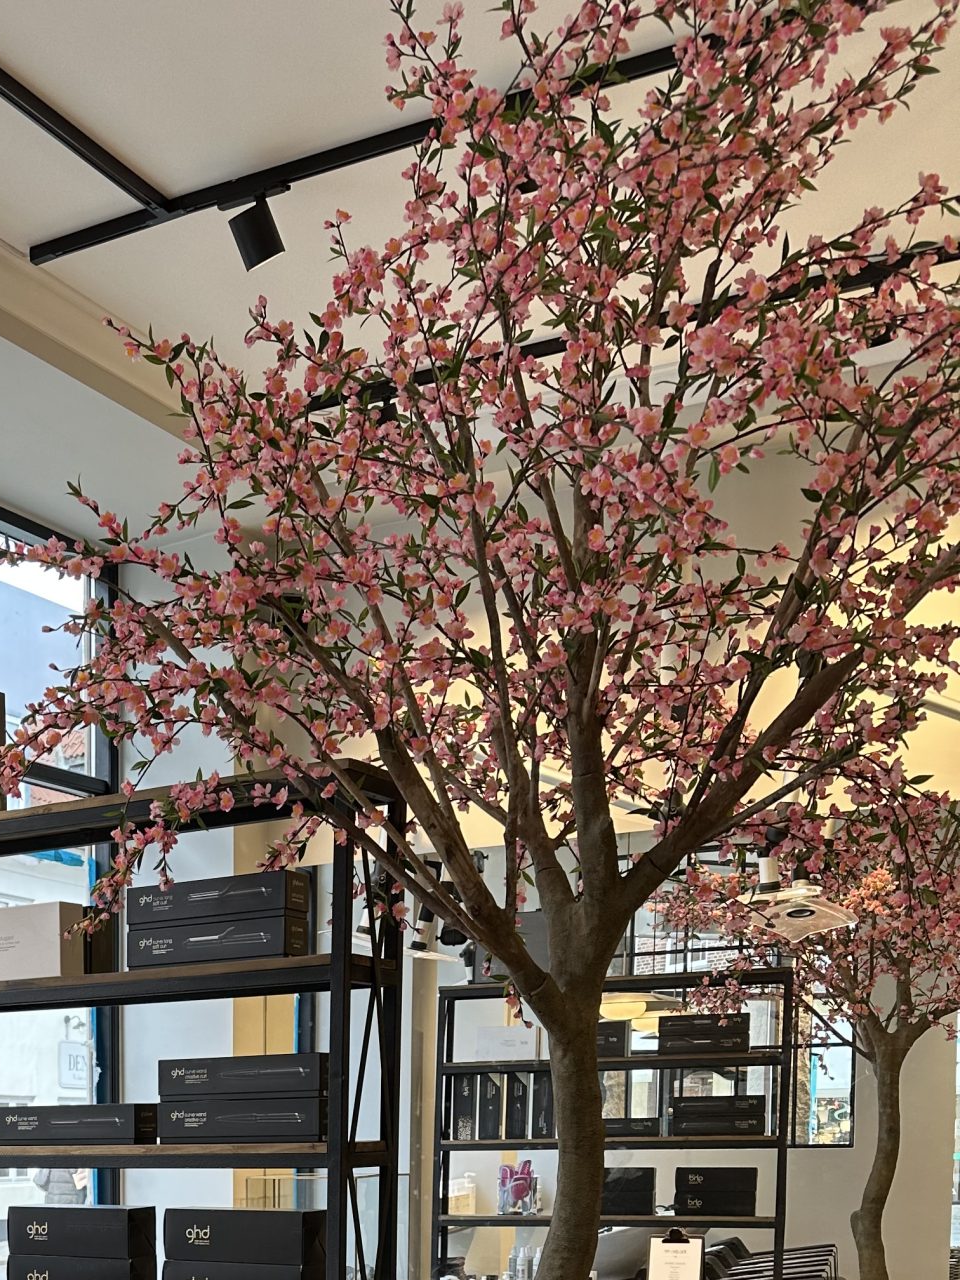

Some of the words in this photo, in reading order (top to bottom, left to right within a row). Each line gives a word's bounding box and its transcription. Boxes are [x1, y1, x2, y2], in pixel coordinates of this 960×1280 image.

[139, 894, 153, 906] ghd
[138, 937, 153, 950] ghd
[171, 1068, 185, 1079] ghd
[5, 1114, 18, 1125] ghd
[170, 1110, 185, 1121] ghd
[26, 1221, 48, 1239] ghd
[185, 1224, 210, 1243] ghd
